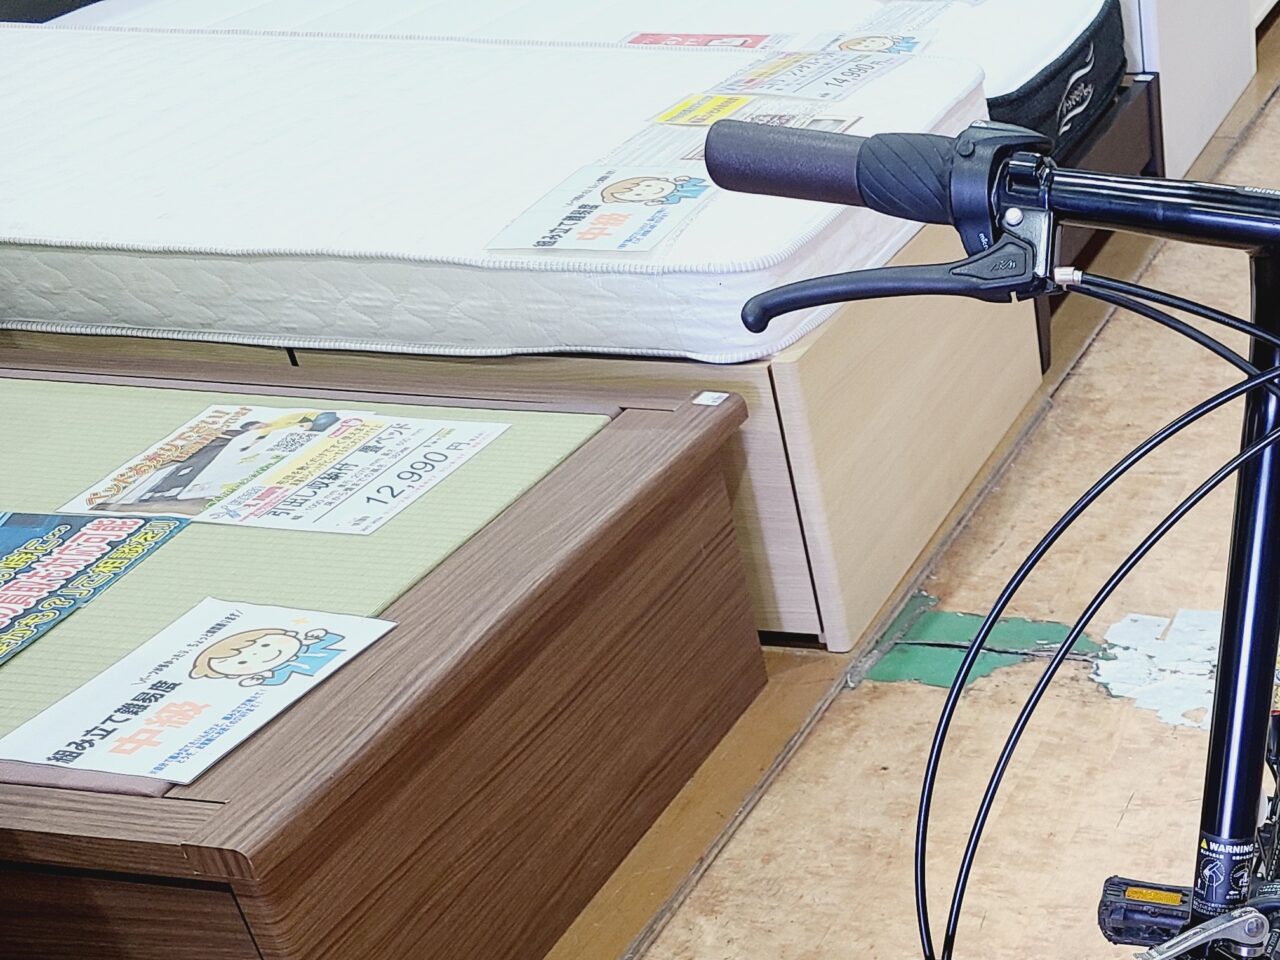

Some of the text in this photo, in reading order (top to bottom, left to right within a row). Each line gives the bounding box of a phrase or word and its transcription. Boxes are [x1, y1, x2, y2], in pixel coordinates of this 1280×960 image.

[366, 451, 449, 505] 12,990
[46, 679, 183, 764] 組み立て難易度
[108, 701, 211, 755] 中級
[1209, 841, 1254, 854] WARNING
